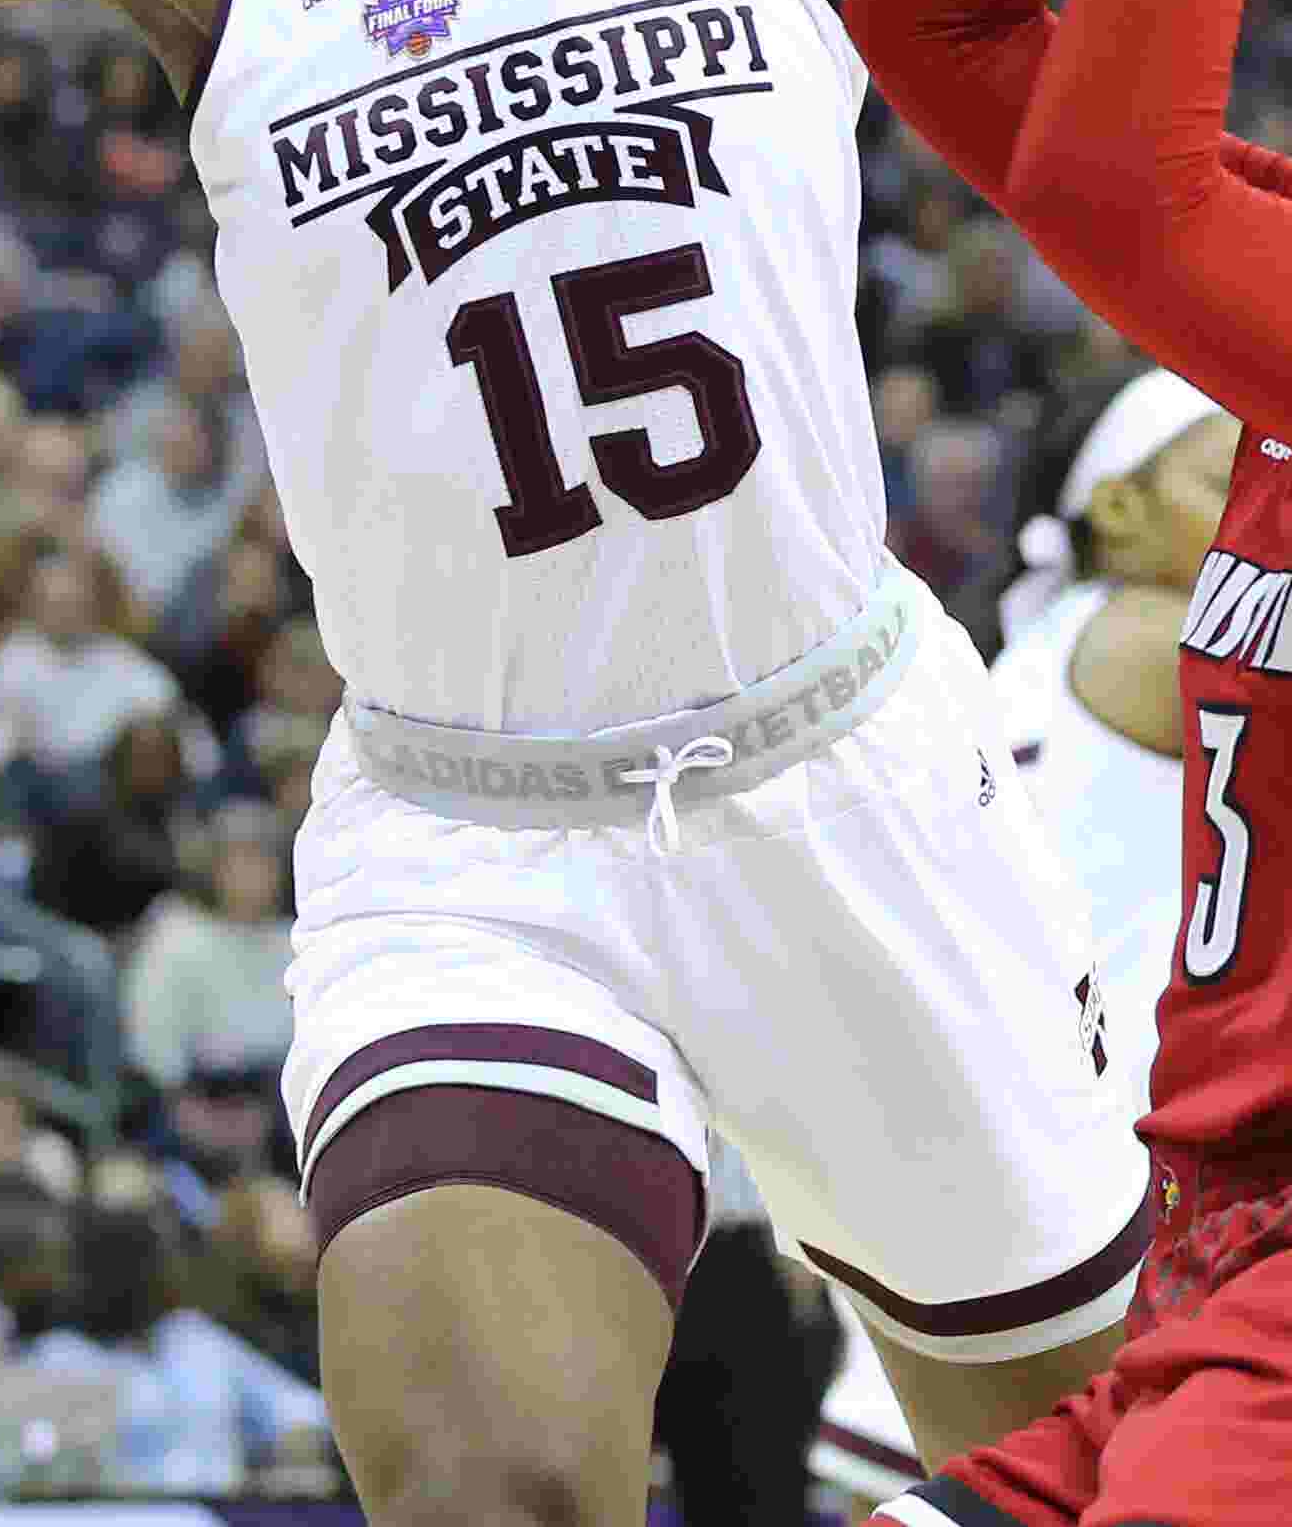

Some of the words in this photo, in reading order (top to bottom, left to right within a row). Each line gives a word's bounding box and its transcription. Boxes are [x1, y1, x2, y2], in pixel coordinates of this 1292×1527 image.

[369, 4, 410, 31] FINAL
[273, 5, 769, 208] MISSISSIPPI
[429, 135, 665, 250] STATE
[446, 242, 761, 557] 15
[377, 743, 590, 801] ADIDAS
[1183, 703, 1253, 982] 3
